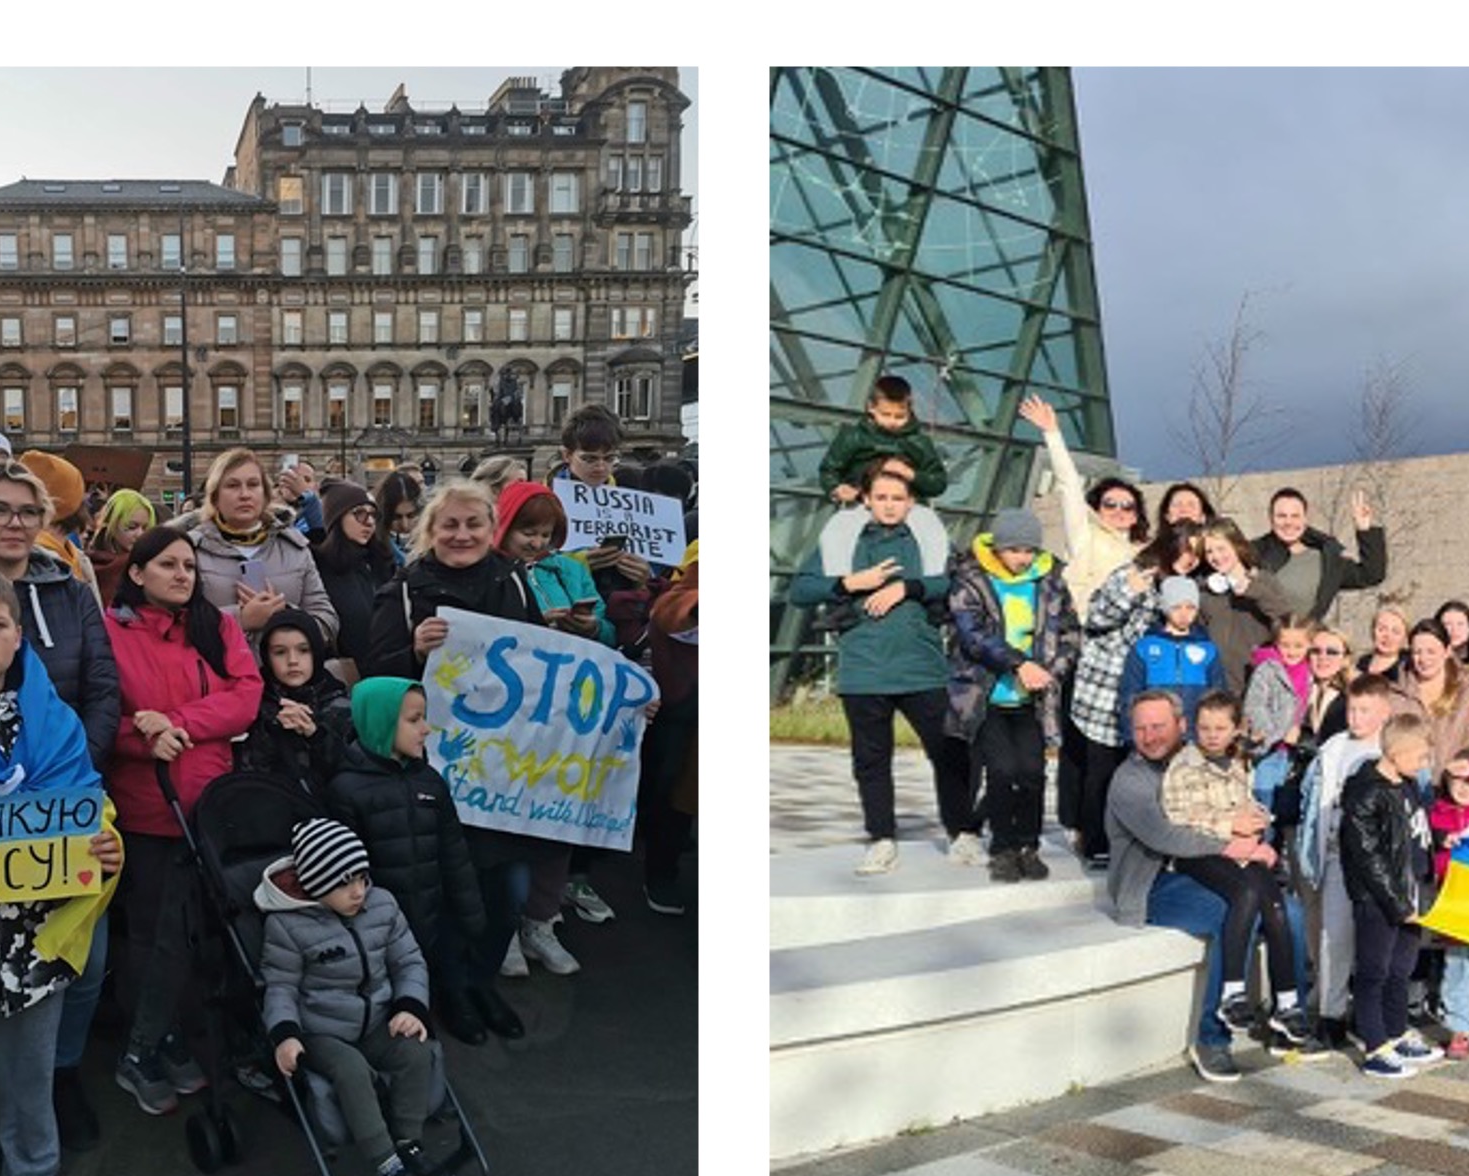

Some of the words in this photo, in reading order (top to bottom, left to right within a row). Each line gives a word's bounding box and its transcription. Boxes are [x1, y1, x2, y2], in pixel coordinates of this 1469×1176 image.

[574, 484, 654, 516] RUSSIA
[596, 508, 611, 519] IS
[571, 519, 676, 543] TERRORIST
[595, 536, 663, 558] SATE
[451, 636, 653, 736] STOP
[529, 798, 571, 823] with
